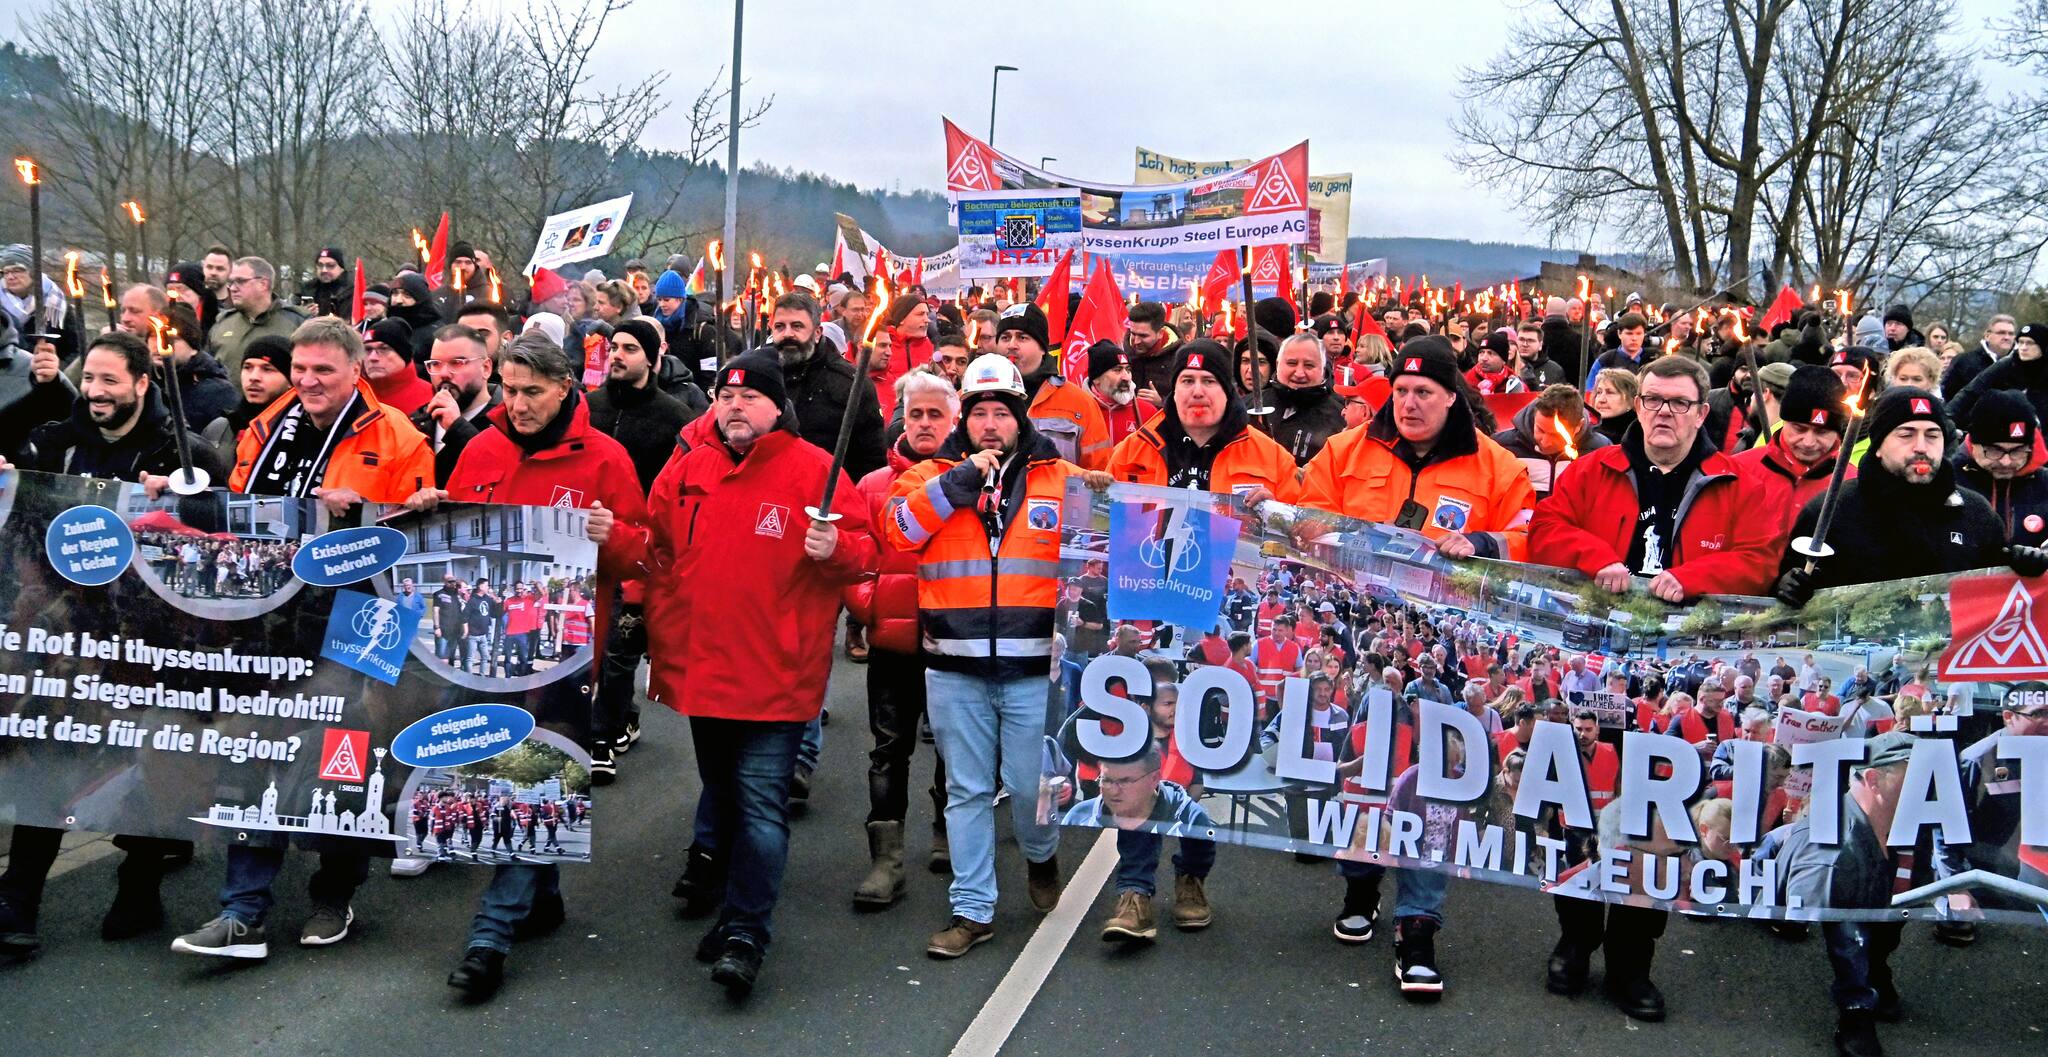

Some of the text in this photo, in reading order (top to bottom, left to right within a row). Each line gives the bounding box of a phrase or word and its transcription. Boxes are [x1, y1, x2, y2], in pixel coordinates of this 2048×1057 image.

[1139, 151, 1164, 170] Ich
[1169, 160, 1196, 176] hab
[1011, 200, 1060, 210] Belegschaft
[1184, 227, 1221, 243] Steel
[1225, 224, 1279, 239] Europe
[1282, 219, 1306, 233] AG
[985, 248, 1060, 265] JETZT!
[62, 517, 106, 536] Zukunft
[61, 536, 119, 555] der Region
[312, 535, 381, 560] Existenzen
[69, 555, 117, 573] in Gefahr
[324, 553, 378, 577] bedroht
[1119, 575, 1213, 603] thyssenkrupp
[27, 627, 75, 656] Rot
[80, 630, 120, 661] bei
[125, 638, 314, 682] thyssenkrupp:
[32, 668, 67, 698] im
[72, 674, 213, 710] Siegerland
[219, 687, 345, 723] bedroht!!!
[2009, 689, 2048, 707] SIEG
[430, 713, 489, 737] steigende
[1805, 718, 1839, 733] Gather
[54, 715, 102, 744] das
[107, 719, 148, 749] für
[153, 724, 195, 753] die
[199, 728, 301, 764] Region?
[416, 727, 512, 759] Arbeitslosigkeit
[341, 784, 364, 793] SIEGEN
